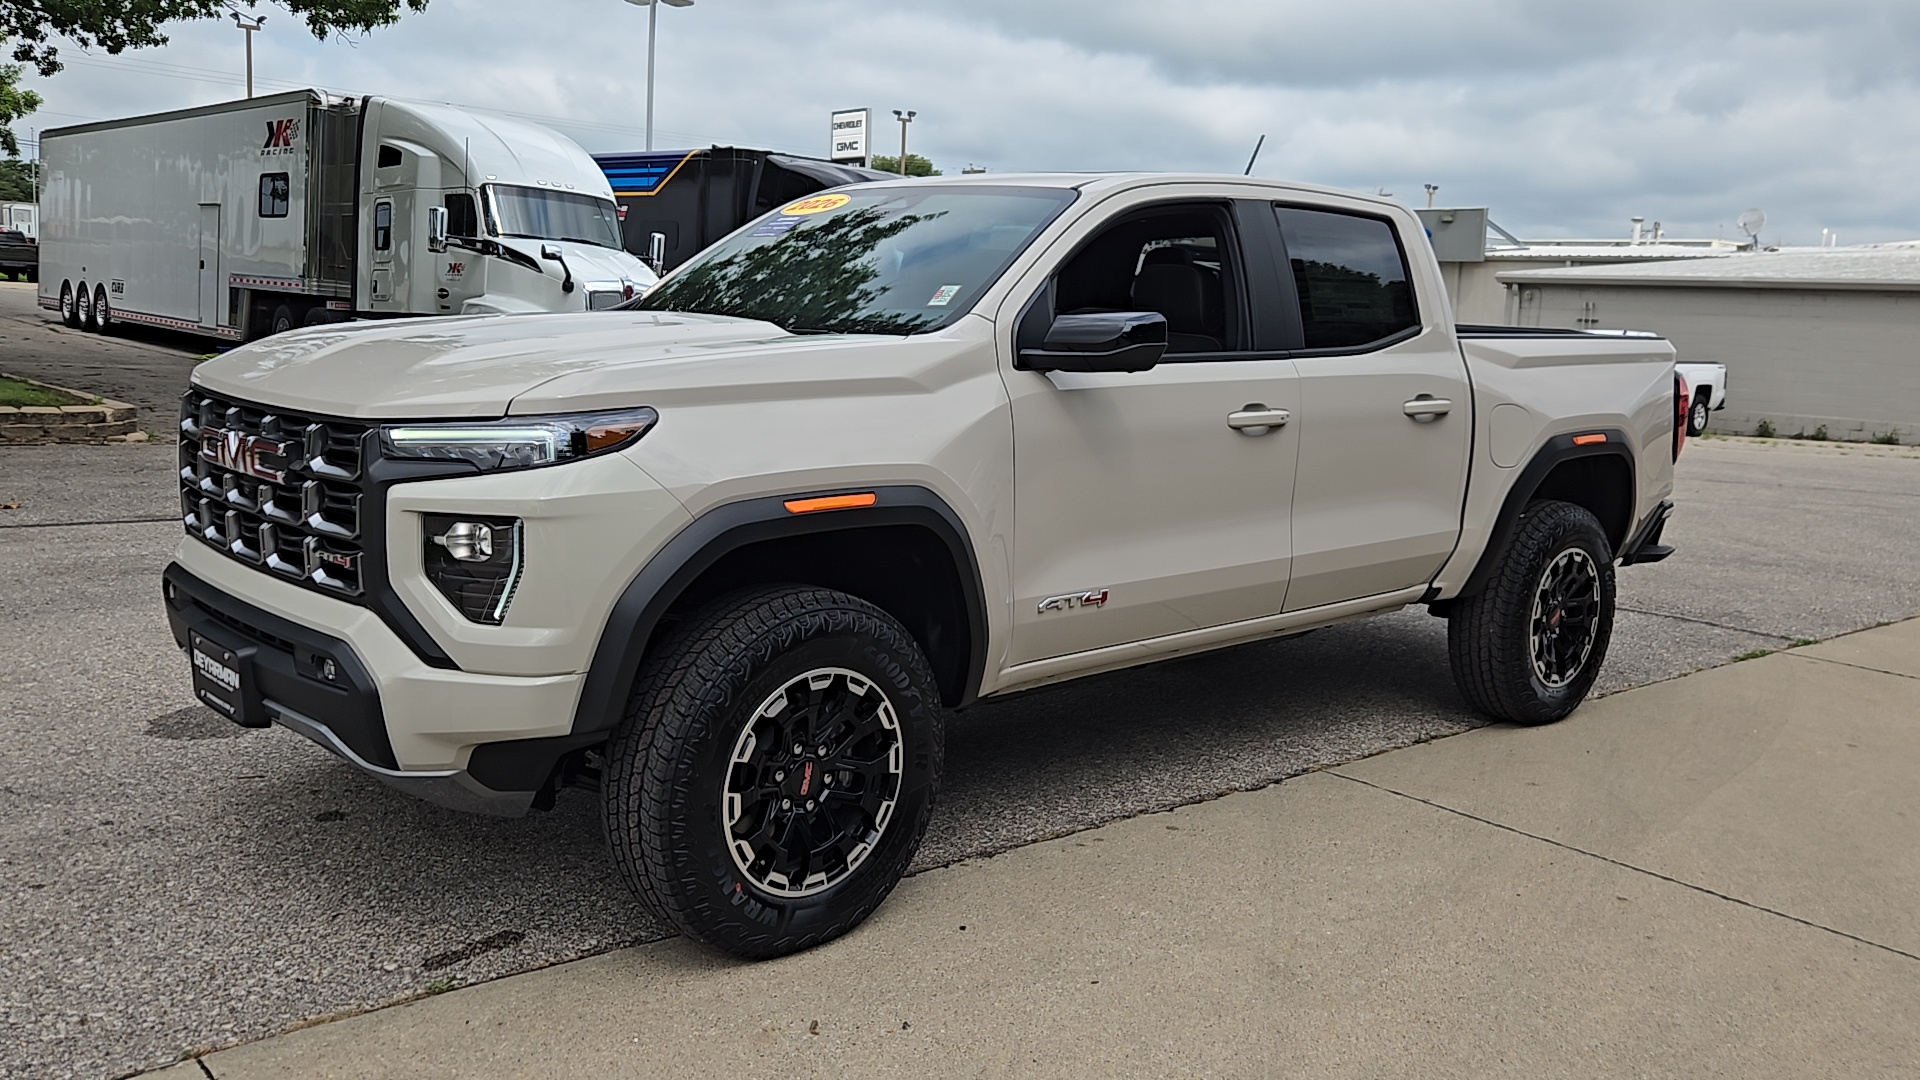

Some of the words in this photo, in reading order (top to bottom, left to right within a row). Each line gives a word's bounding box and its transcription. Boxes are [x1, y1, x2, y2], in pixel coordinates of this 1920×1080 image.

[833, 120, 862, 130] CHEVROLET
[260, 148, 294, 156] RACING
[837, 141, 858, 151] GMC
[786, 198, 845, 211] 2026
[202, 427, 289, 484] GMC
[315, 551, 350, 568] AT4
[1038, 588, 1109, 614] AT4
[800, 761, 813, 796] GMC
